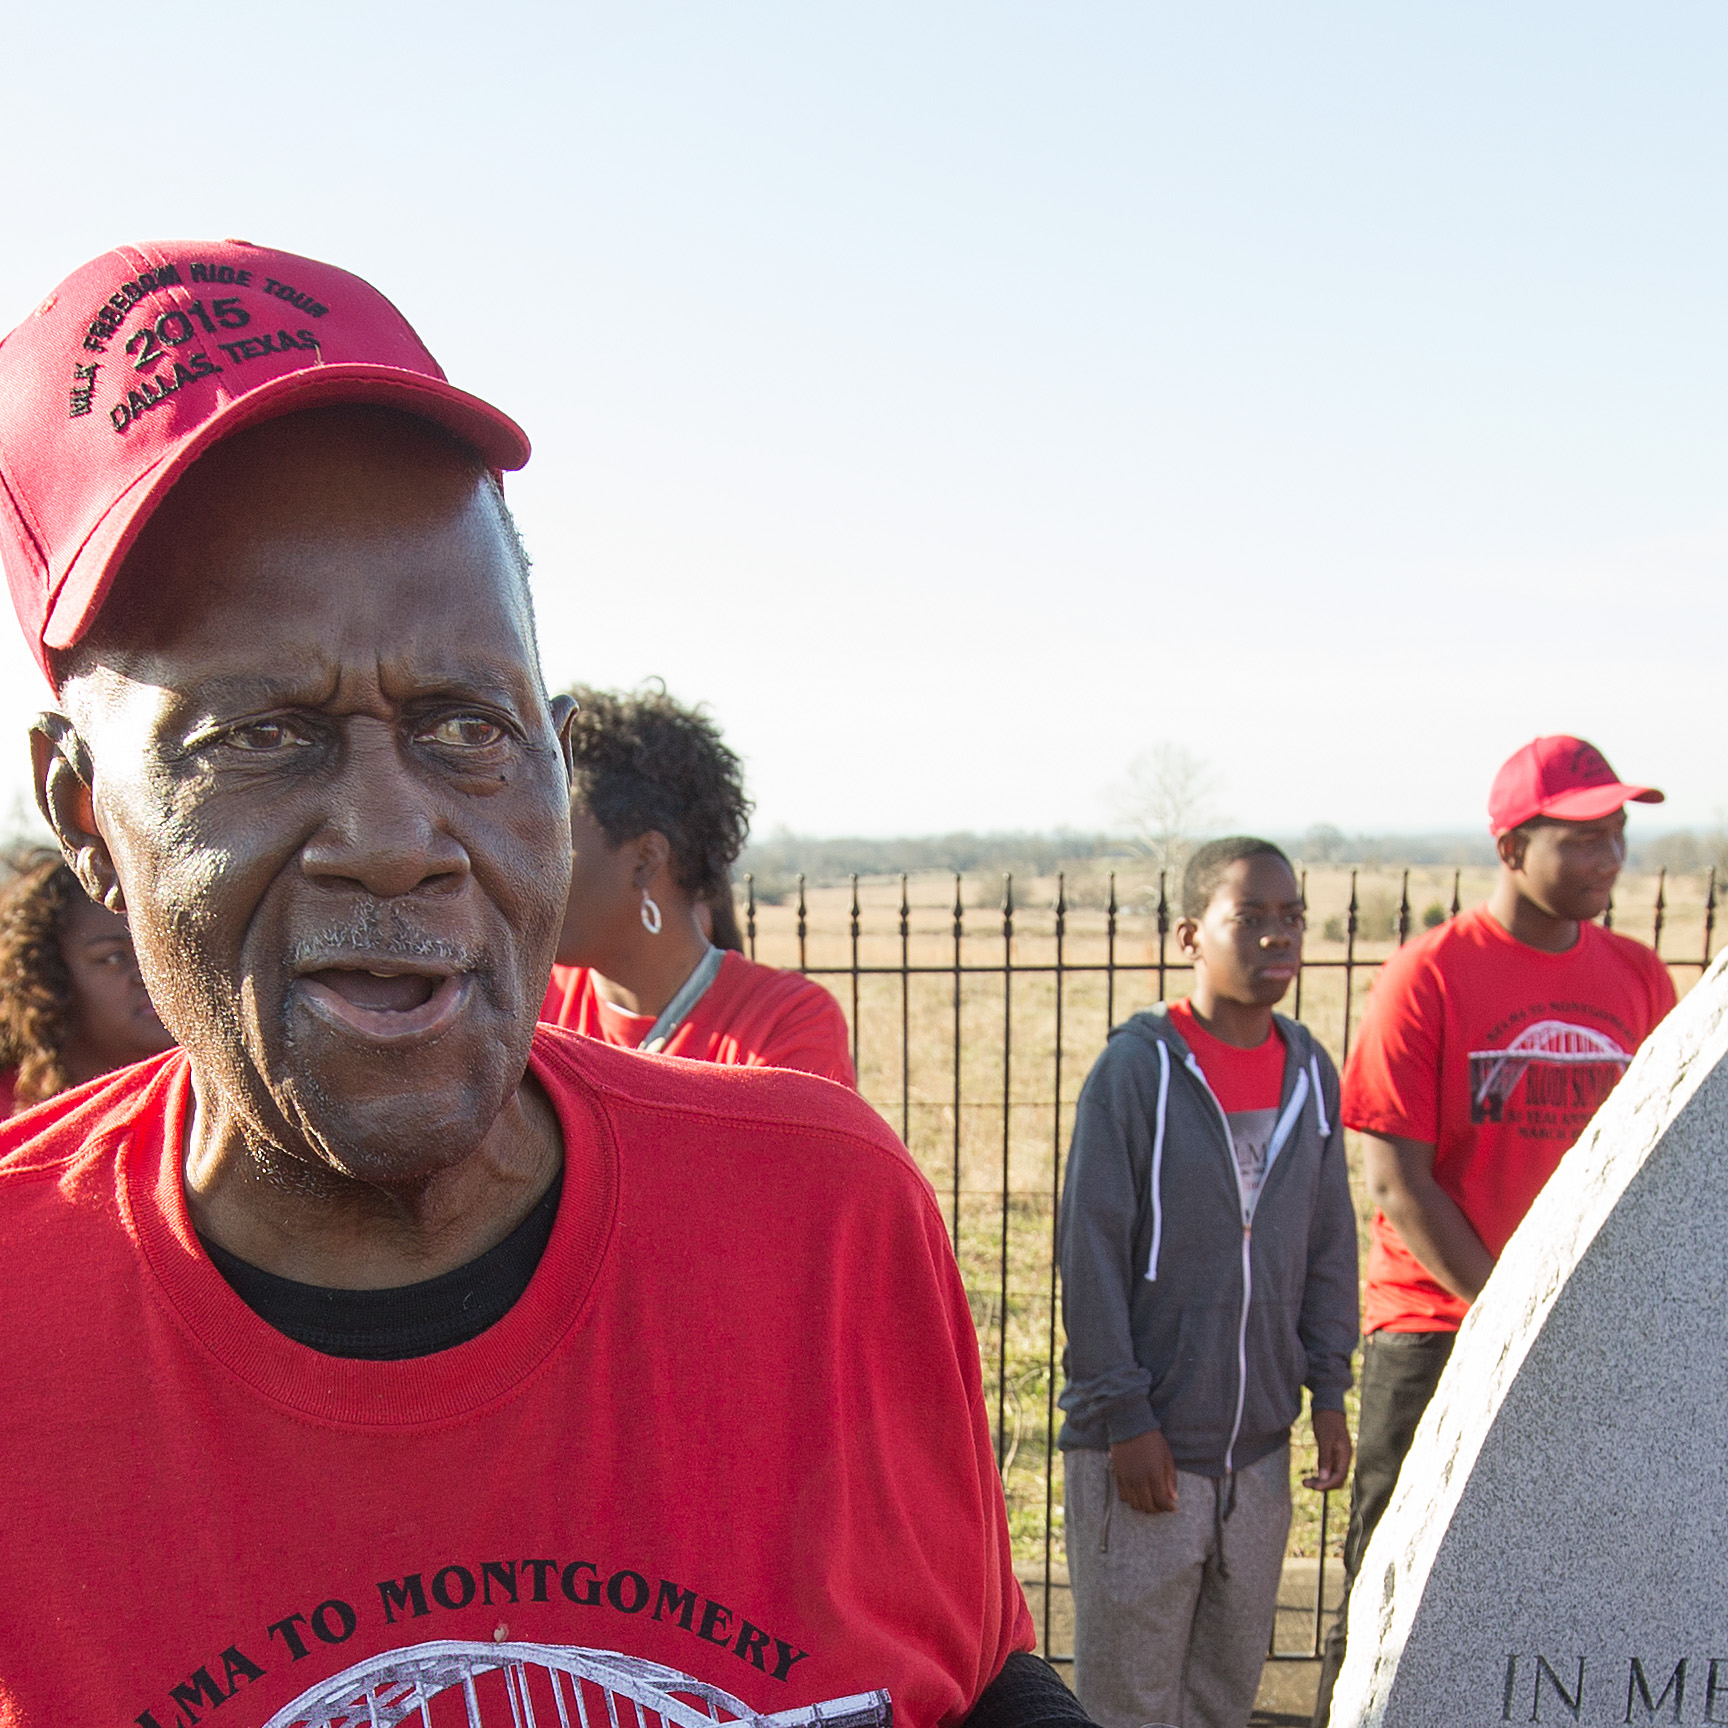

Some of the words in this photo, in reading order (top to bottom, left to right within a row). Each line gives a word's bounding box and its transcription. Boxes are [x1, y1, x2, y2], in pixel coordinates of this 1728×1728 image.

[83, 264, 183, 352] FREEDOM
[190, 262, 253, 287] RIDE
[264, 277, 329, 318] TOUR
[125, 296, 250, 370] 2015
[217, 329, 321, 364] TEXAS
[267, 1598, 359, 1665] TO
[376, 1559, 811, 1685] MONTGOMERY
[1500, 1653, 1586, 1722] IN
